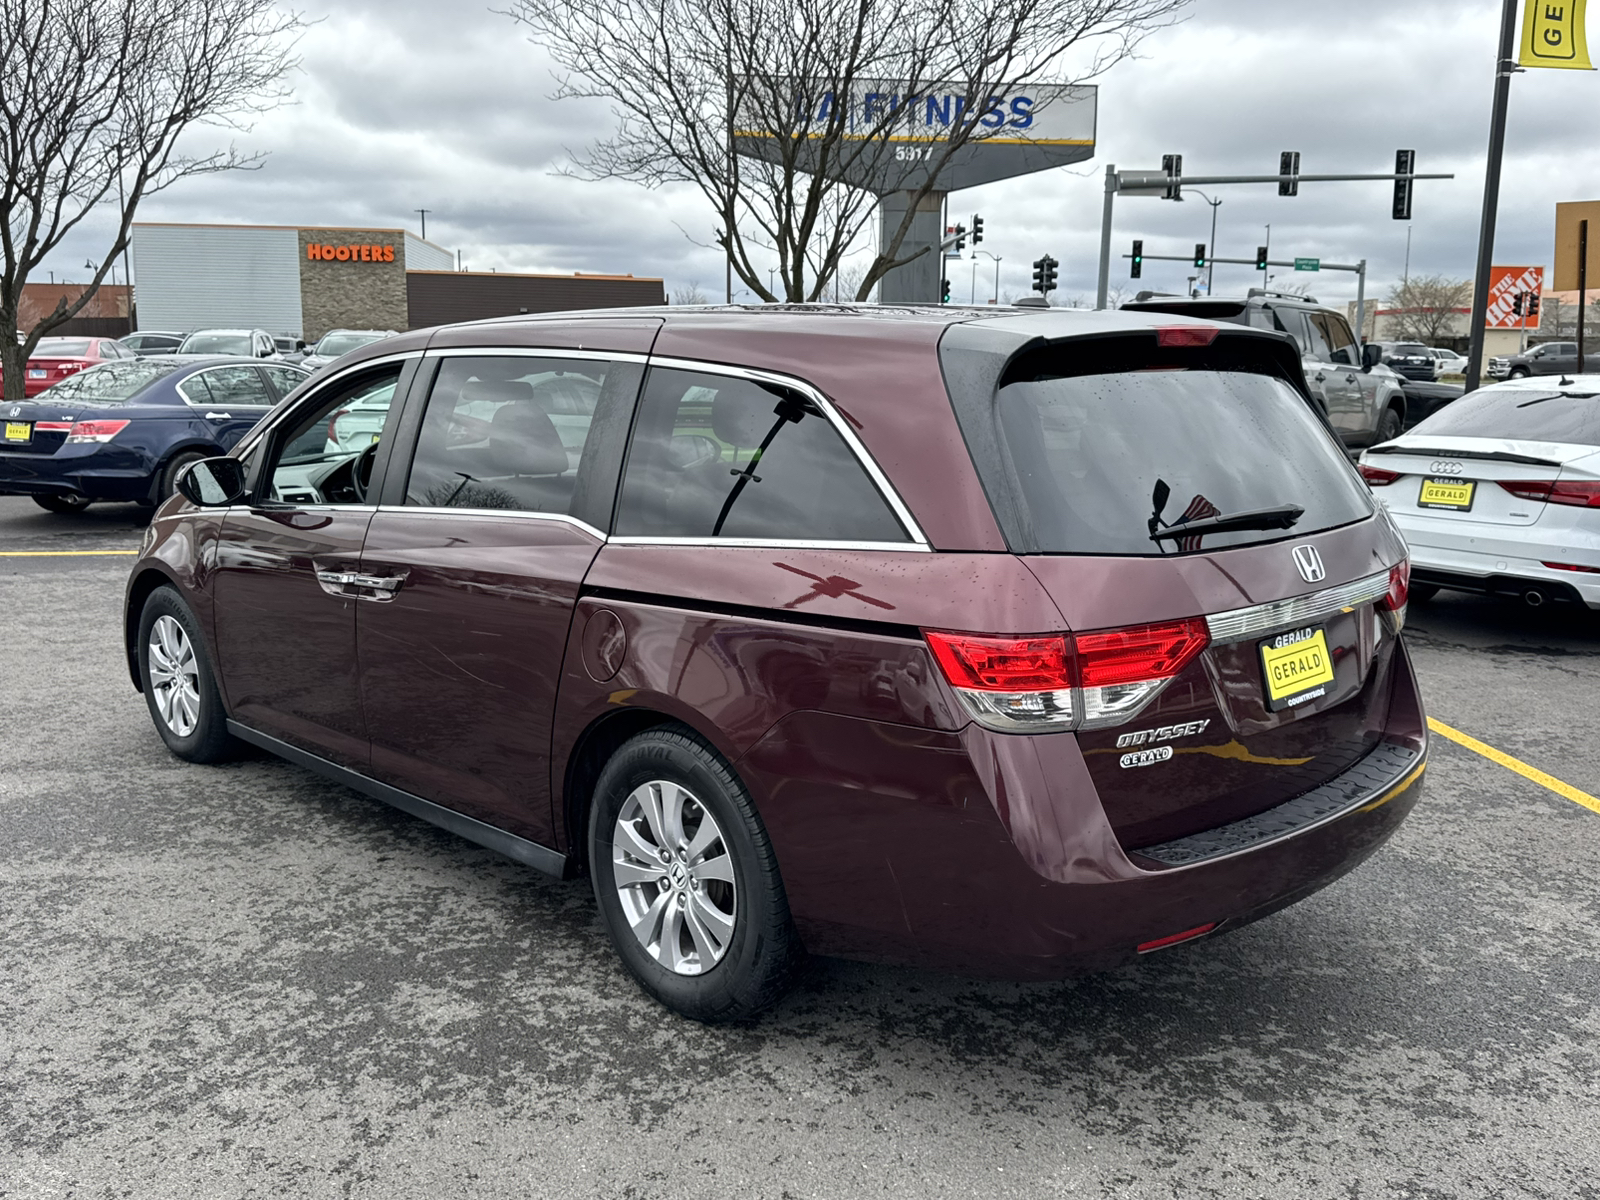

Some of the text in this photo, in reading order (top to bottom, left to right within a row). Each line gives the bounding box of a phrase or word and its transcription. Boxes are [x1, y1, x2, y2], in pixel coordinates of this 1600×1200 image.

[307, 243, 395, 262] HOOTERS
[1490, 273, 1515, 297] THE
[1486, 267, 1542, 327] HOME
[1427, 489, 1465, 499] GERALD
[1275, 628, 1312, 649] GERALD
[1274, 653, 1321, 681] GERALD
[1287, 687, 1325, 707] COUNTRYSIDE
[1116, 719, 1211, 748] ODYSSEY
[1122, 747, 1170, 766] GERALD
